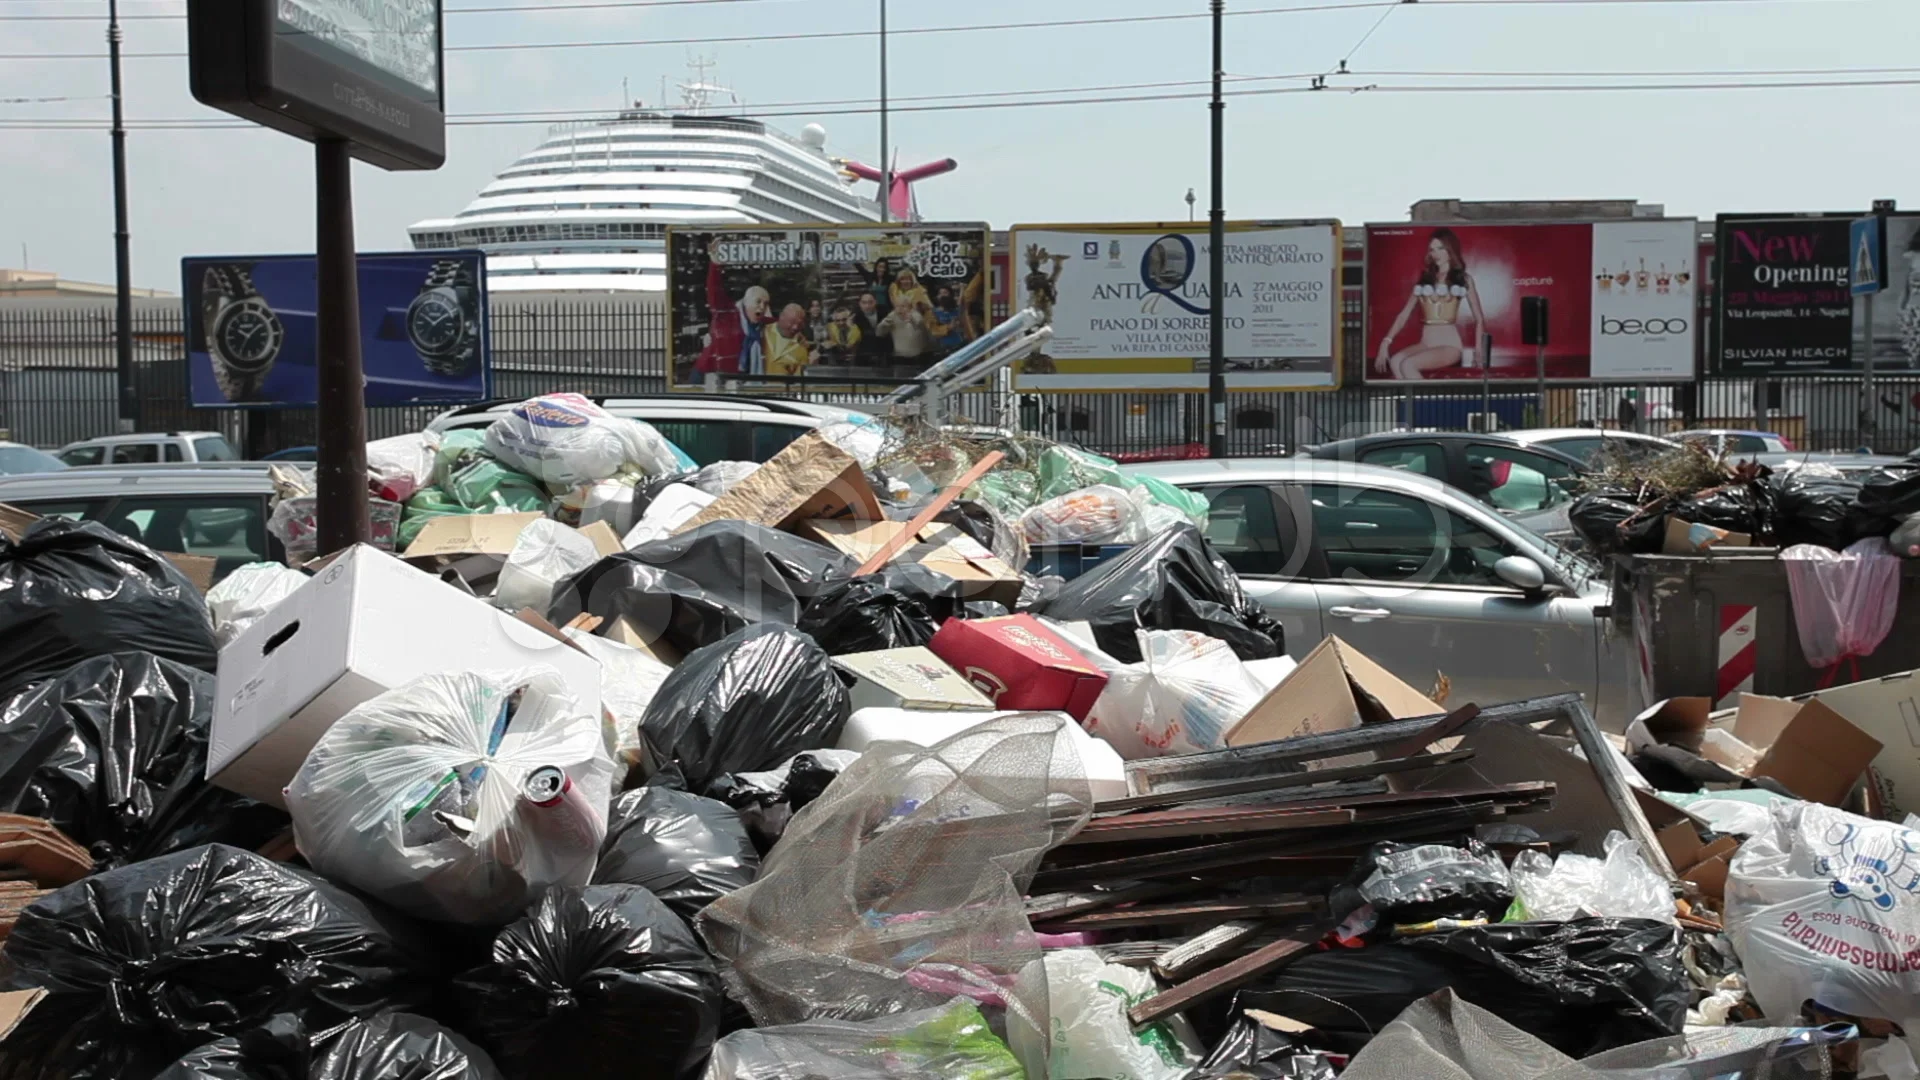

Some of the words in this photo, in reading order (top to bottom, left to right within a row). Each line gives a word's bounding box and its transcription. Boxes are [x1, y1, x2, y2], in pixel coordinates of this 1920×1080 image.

[717, 241, 794, 262] SENTIRSI
[802, 242, 814, 261] A
[821, 241, 868, 261] CASA
[1201, 244, 1246, 254] MTRA
[1246, 244, 1298, 254] MERCATO
[1727, 229, 1823, 263] New
[930, 252, 951, 264] do
[1754, 264, 1849, 288] Opening
[1252, 281, 1266, 292] 27
[1268, 280, 1323, 292] MAGGIO
[1252, 292, 1260, 303] 5
[1262, 291, 1318, 302] GIUGNO
[1727, 308, 1744, 318] Via
[1090, 318, 1138, 331] PIANO
[1141, 318, 1158, 330] DI
[1162, 317, 1244, 330] SORRETO
[1126, 333, 1161, 343] VILLA
[1165, 332, 1209, 343] FONDI
[1111, 344, 1130, 352] VIA
[1132, 344, 1157, 352] RIPA
[1159, 344, 1172, 352] DI
[1724, 348, 1787, 359] SILVIAN
[1791, 347, 1847, 358] HEACH
[1812, 911, 1842, 925] Rosa
[1781, 911, 1920, 974] armasanitaria
